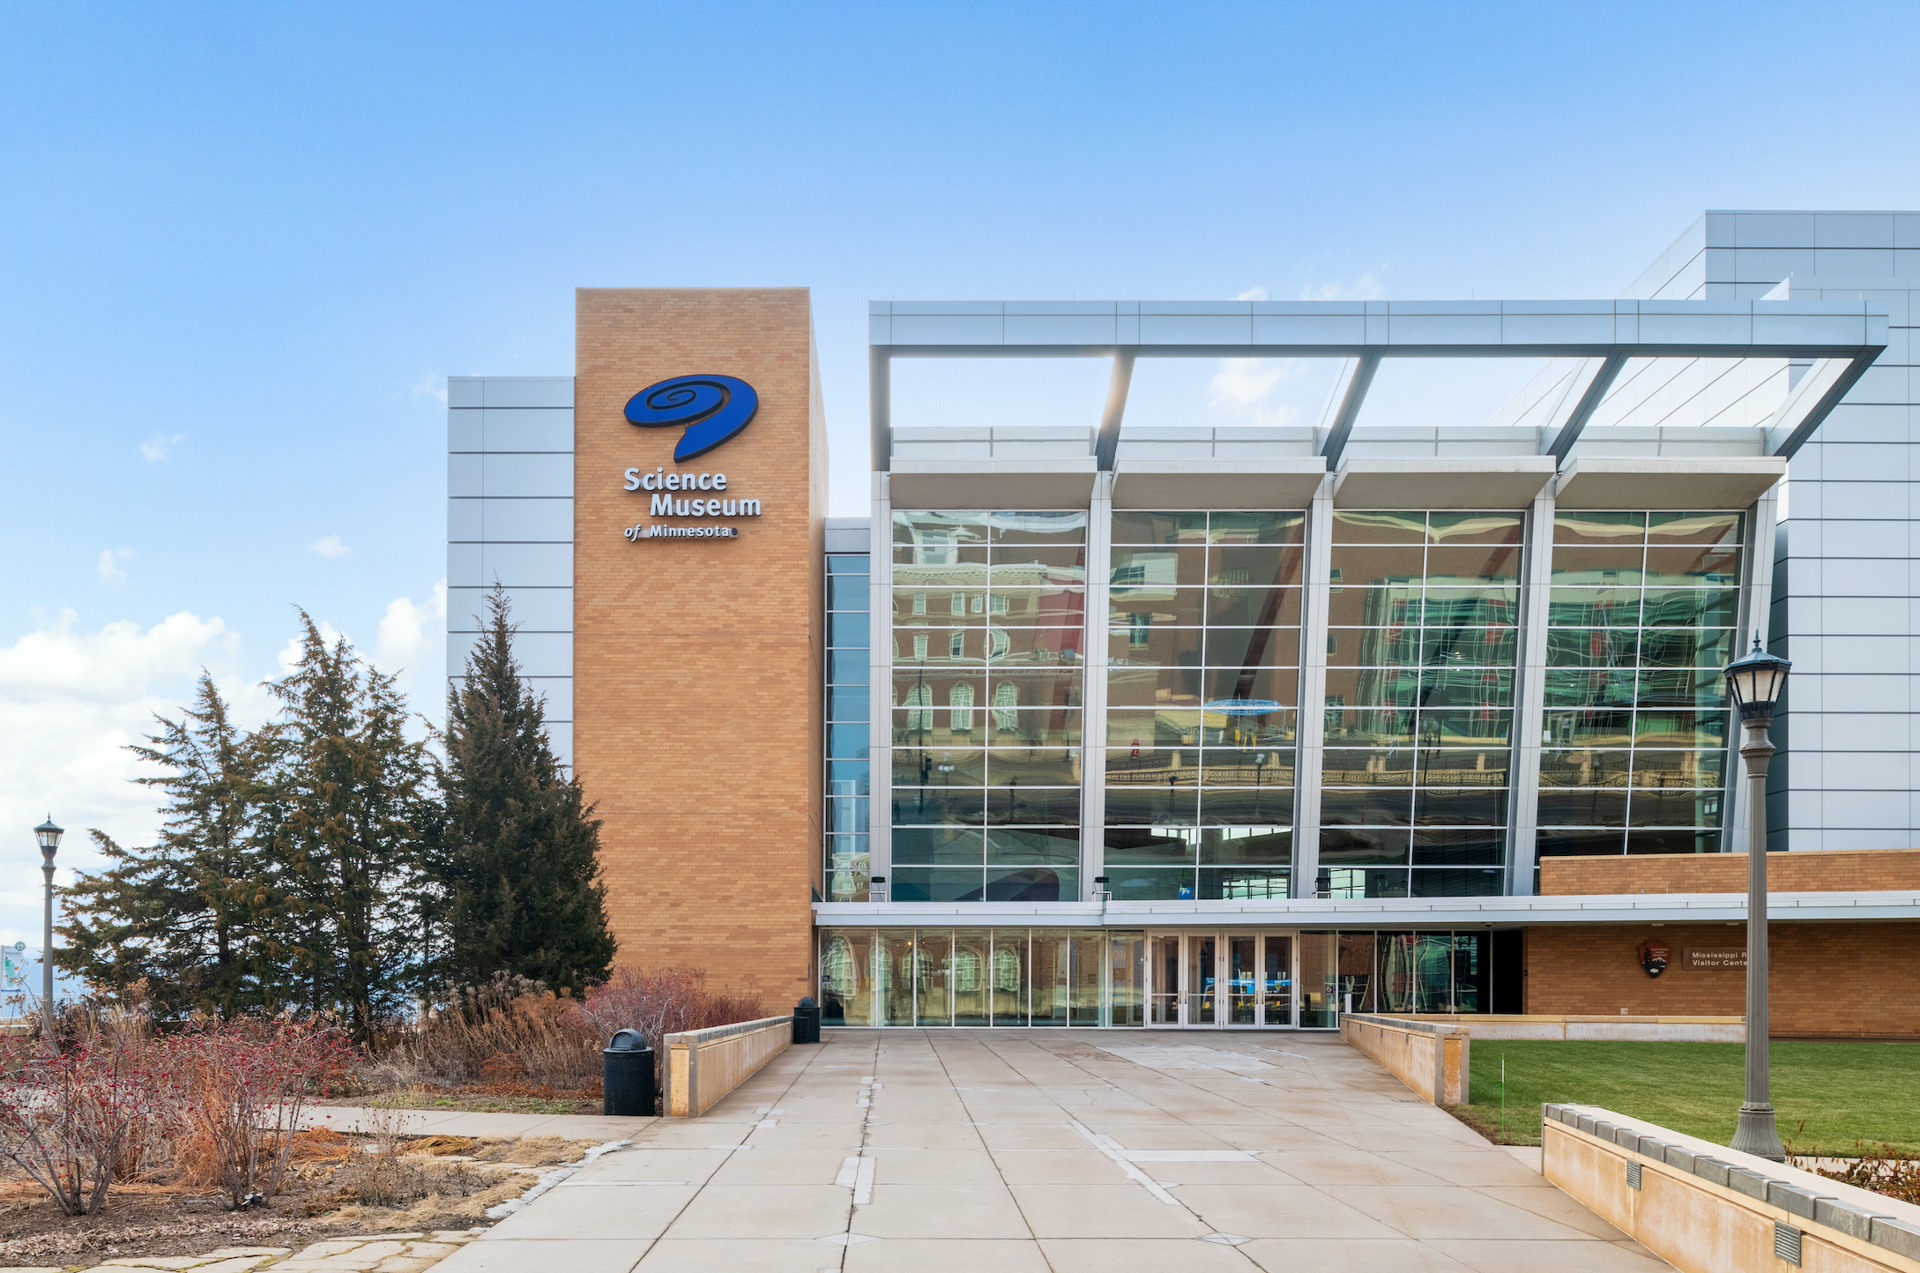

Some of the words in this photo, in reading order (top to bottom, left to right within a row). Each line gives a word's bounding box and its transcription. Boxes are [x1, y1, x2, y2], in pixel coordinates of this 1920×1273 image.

[623, 466, 727, 491] Science
[650, 493, 762, 516] Museum
[624, 524, 642, 542] of
[650, 524, 729, 537] Minnesota
